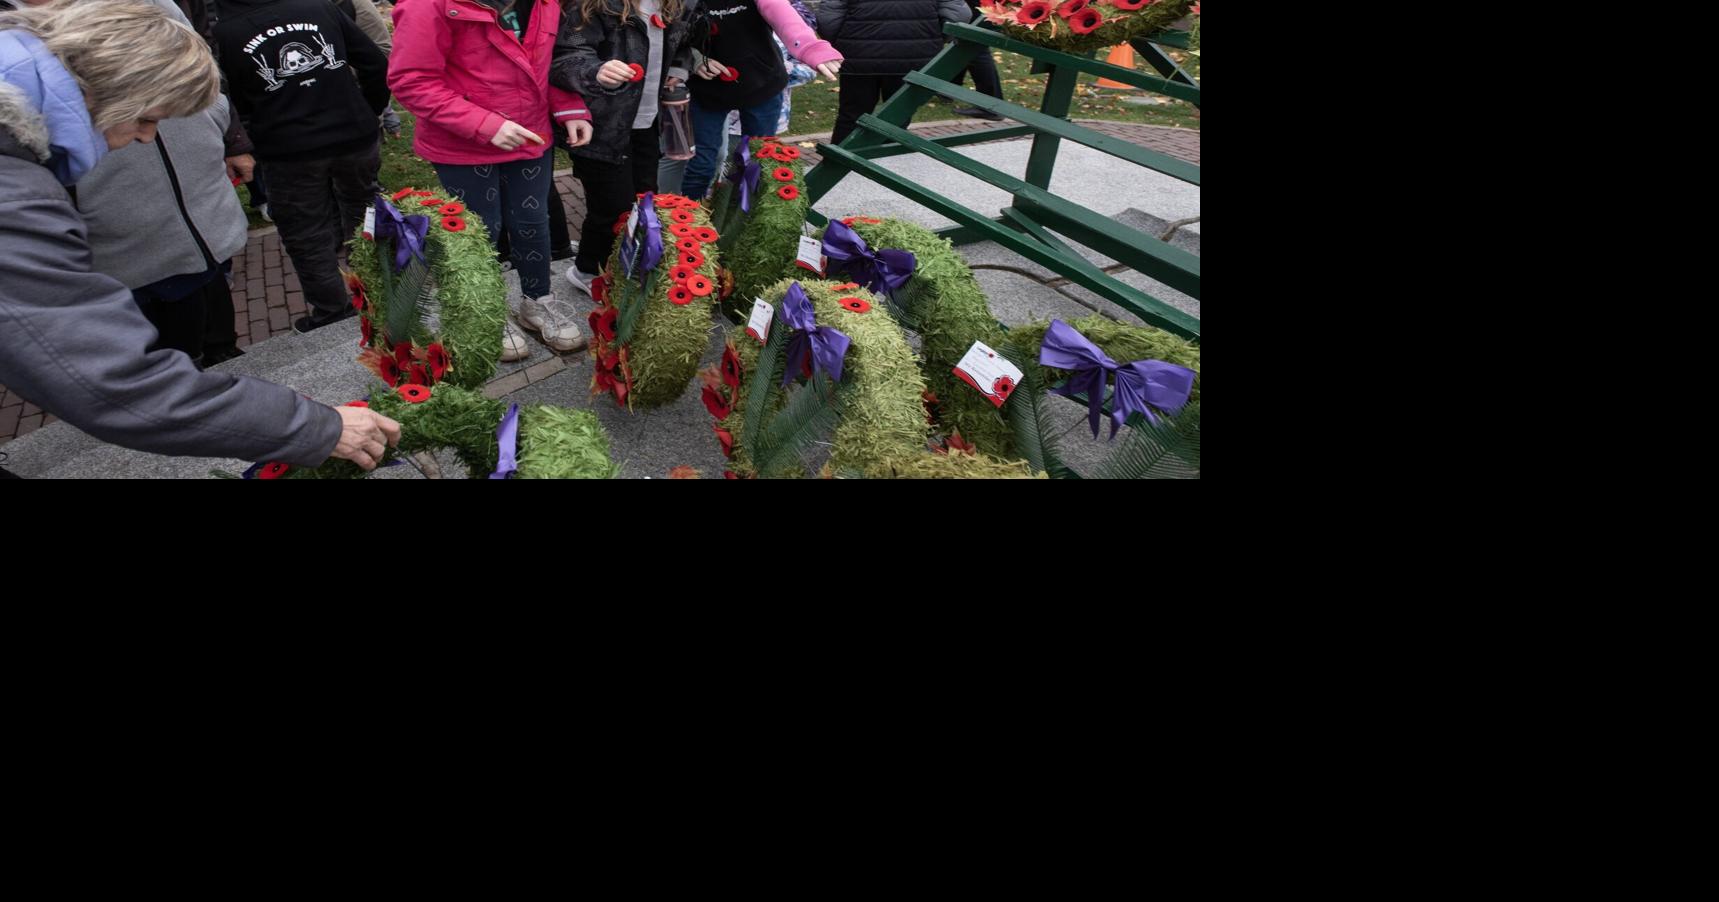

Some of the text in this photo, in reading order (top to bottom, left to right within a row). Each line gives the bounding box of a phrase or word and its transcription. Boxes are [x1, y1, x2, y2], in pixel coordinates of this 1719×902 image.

[243, 23, 318, 54] SINK OR SWIM
